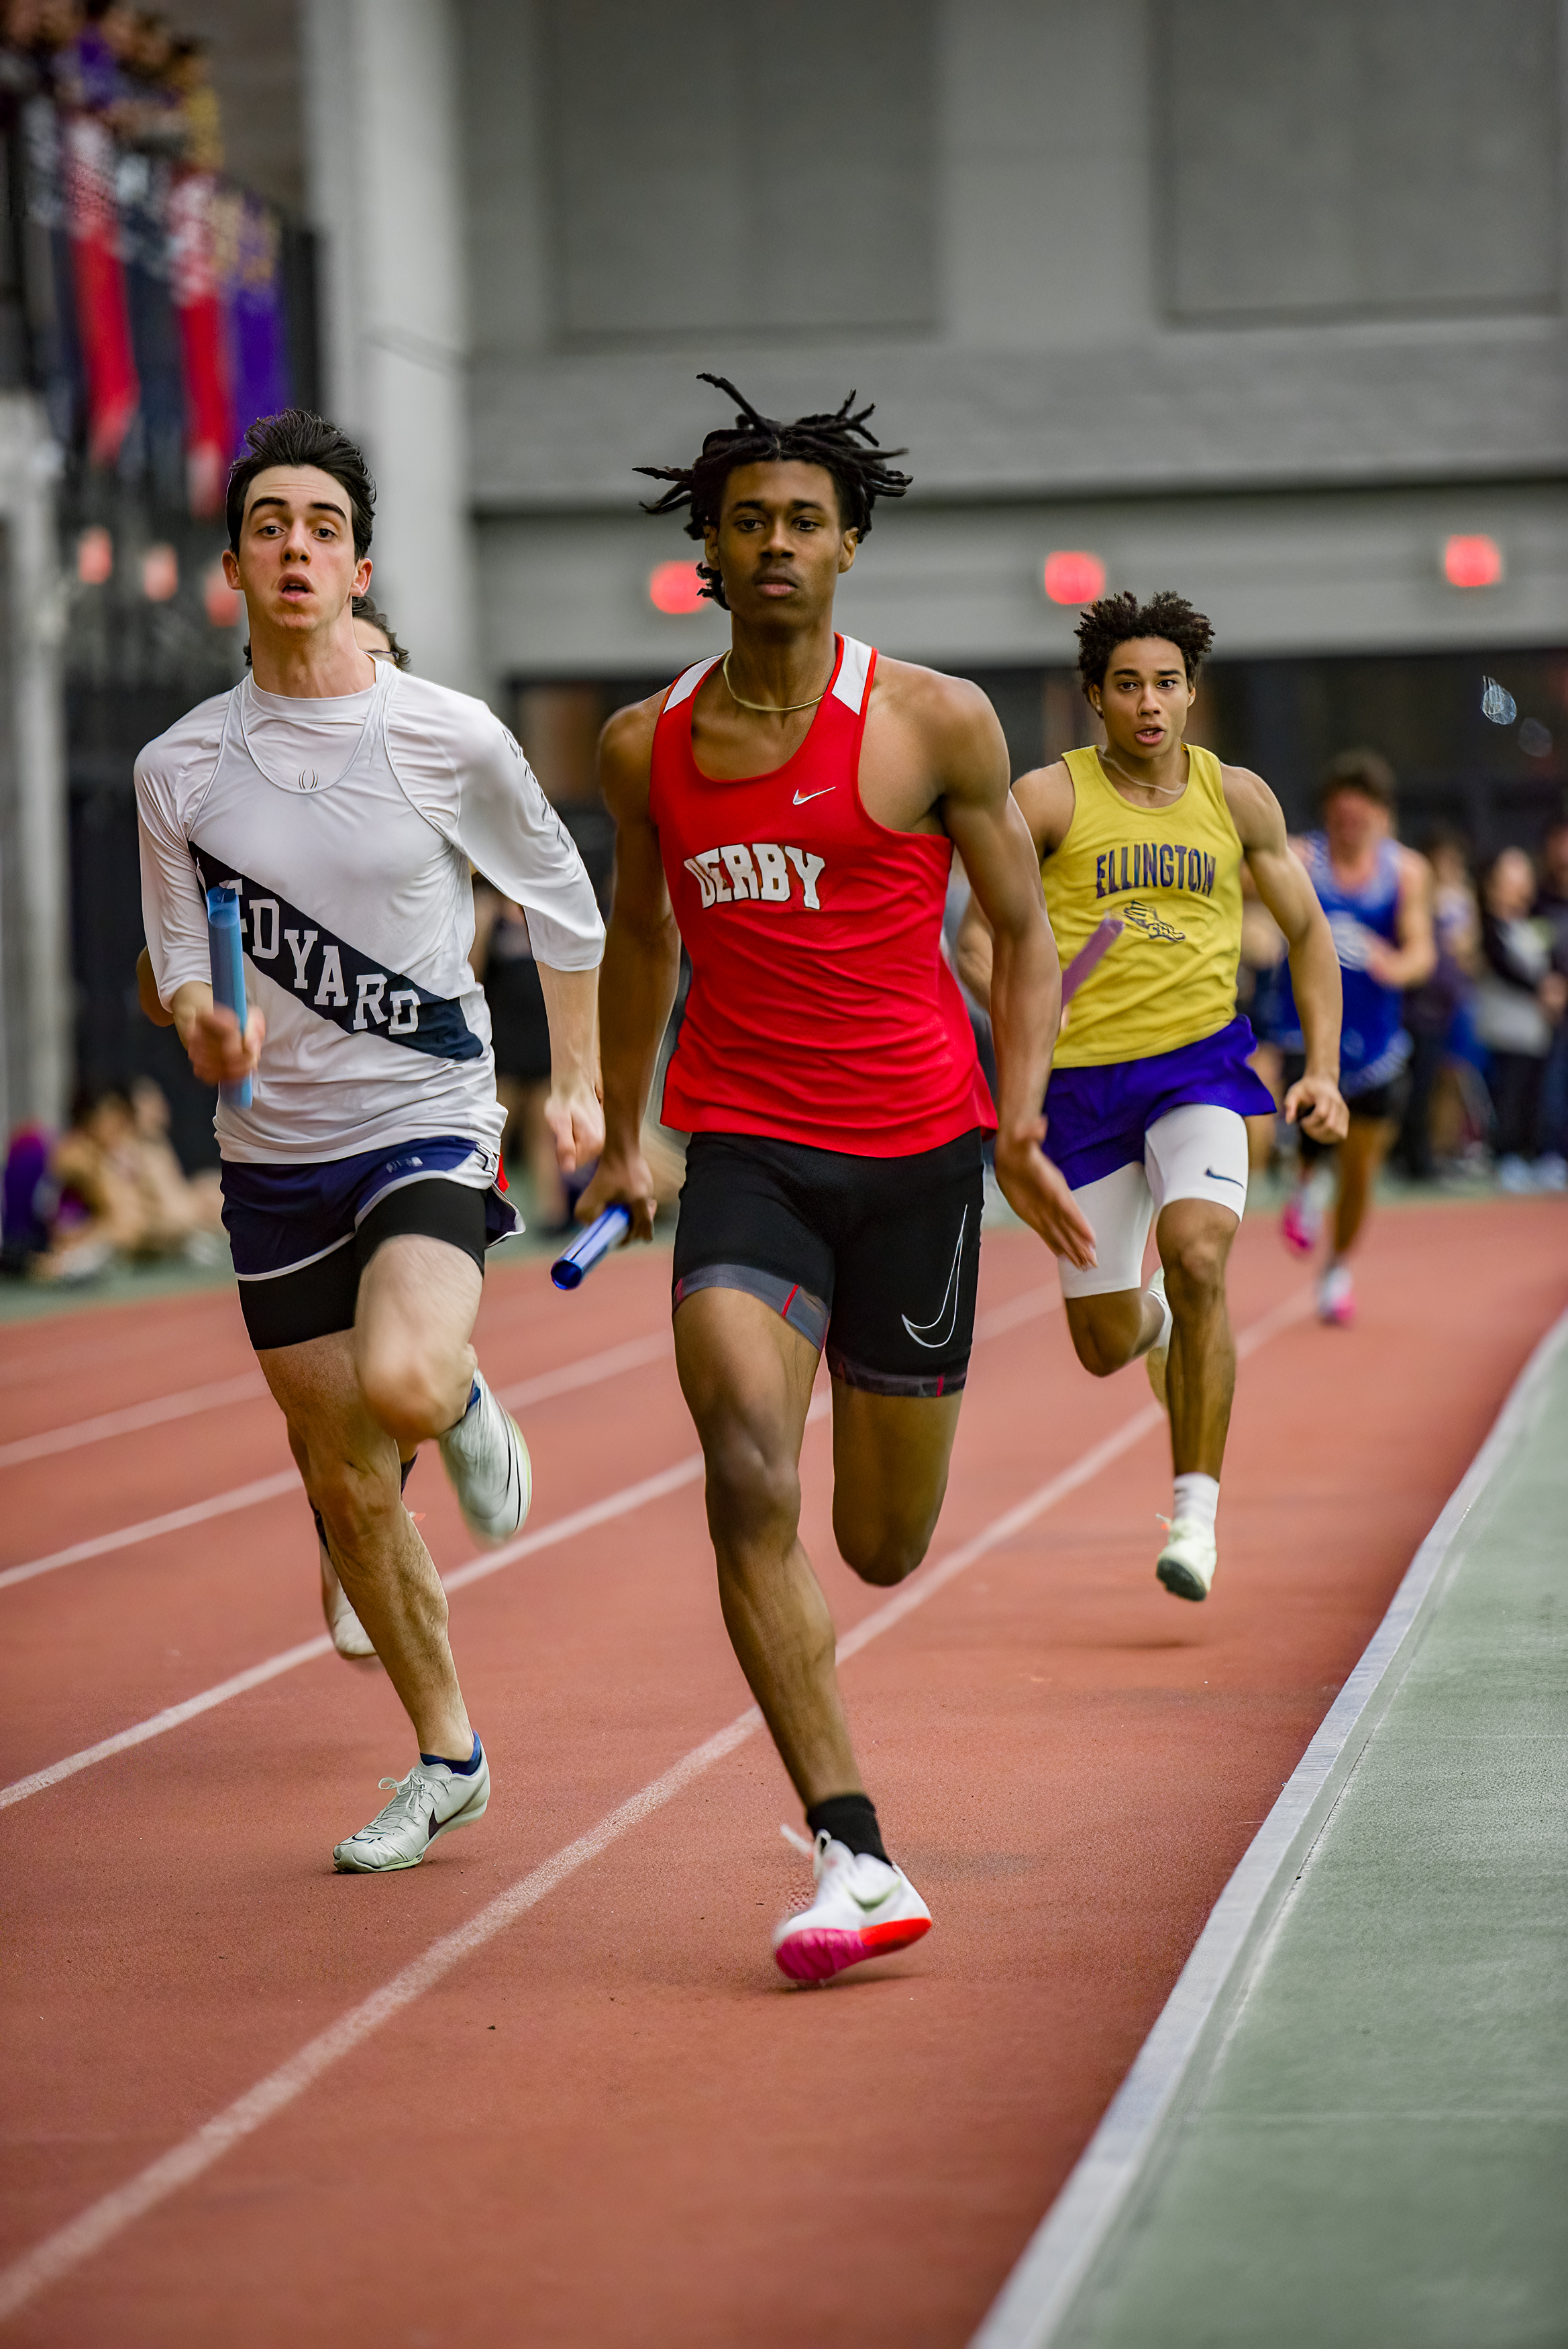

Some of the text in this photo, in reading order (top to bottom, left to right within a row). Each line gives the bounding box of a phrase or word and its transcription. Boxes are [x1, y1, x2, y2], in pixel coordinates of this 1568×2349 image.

[684, 843, 825, 910] DERBY
[1096, 842, 1216, 899] ELLINGTON
[196, 858, 421, 1035] DYARD
